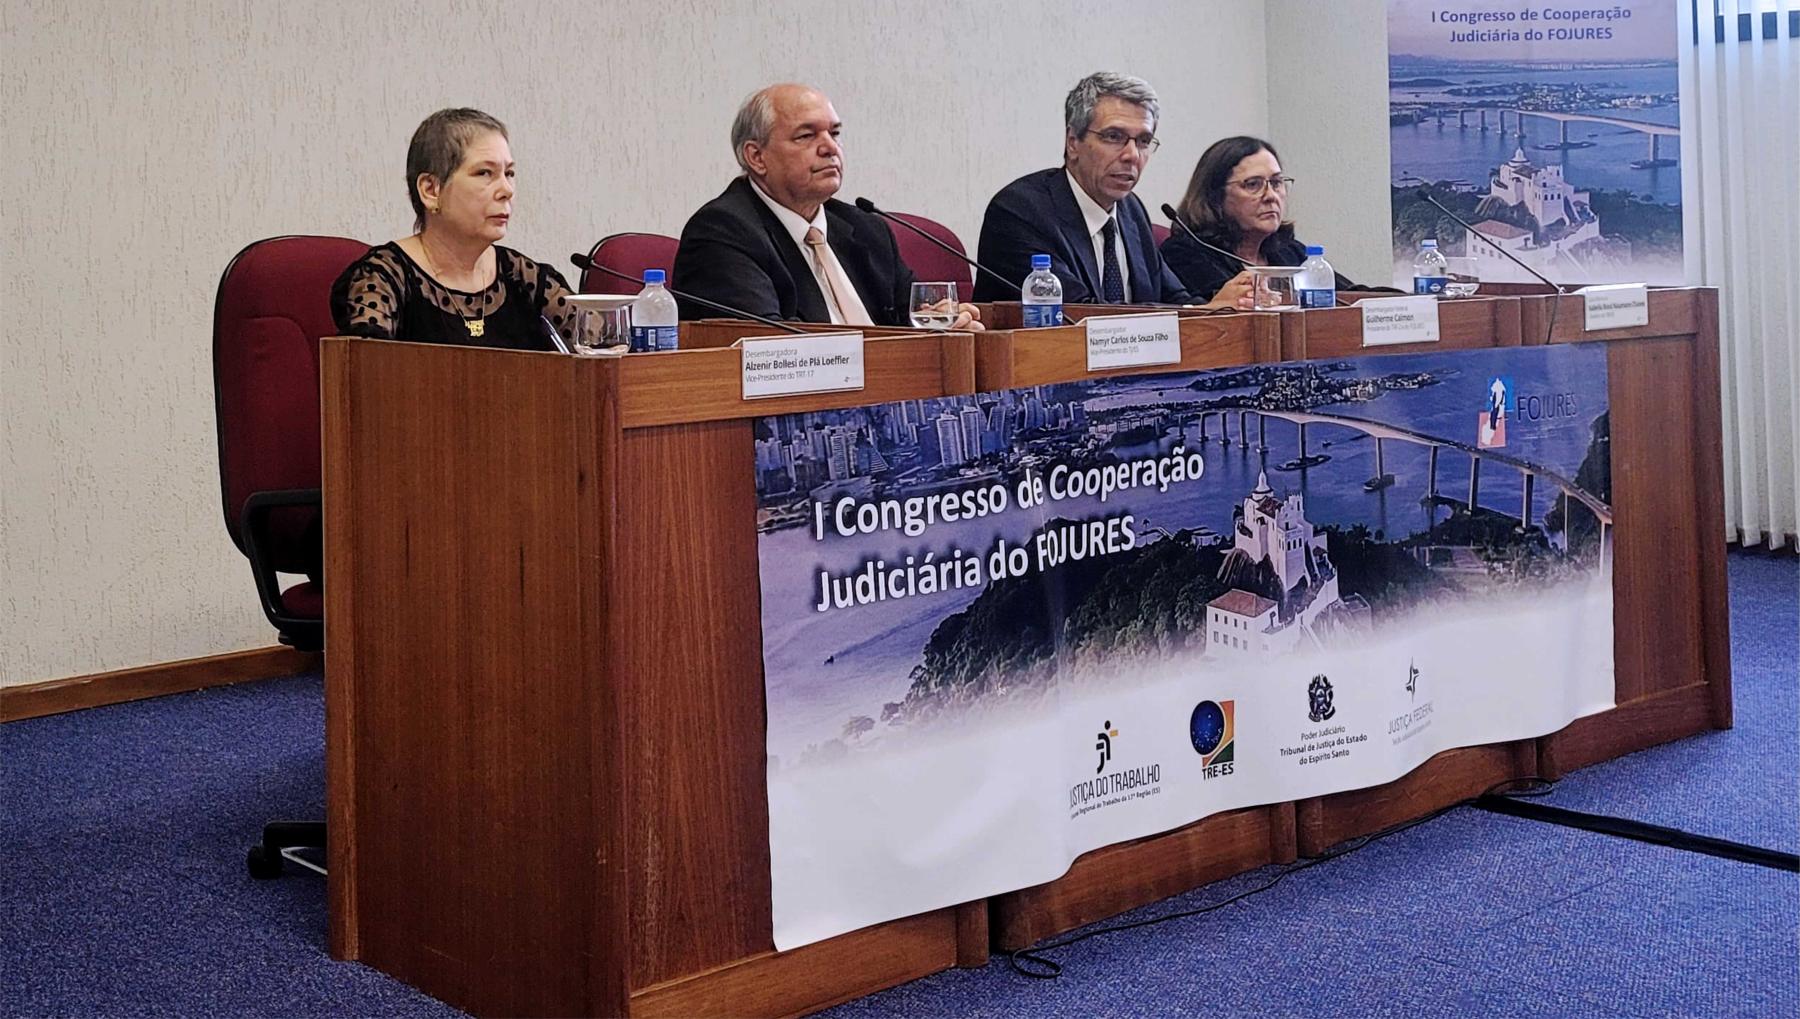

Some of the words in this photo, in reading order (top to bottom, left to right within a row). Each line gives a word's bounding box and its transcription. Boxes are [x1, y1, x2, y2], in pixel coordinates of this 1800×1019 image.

[1432, 11, 1436, 22] I
[1440, 9, 1516, 26] Congresso
[1520, 8, 1538, 21] de
[1543, 7, 1631, 25] Cooperação
[1450, 28, 1519, 43] Judiciária
[1524, 28, 1543, 41] do
[1548, 27, 1613, 41] FOJURES
[1090, 338, 1110, 347] Namyr
[1110, 336, 1129, 344] Carlos
[1129, 335, 1137, 343] de
[1137, 334, 1154, 342] Souza
[1154, 332, 1169, 341] Filho
[745, 348, 798, 359] Desembargadora
[745, 359, 772, 371] Alzenir
[773, 358, 798, 370] Bollesi
[798, 358, 808, 368] de
[821, 355, 850, 366] Loeffler
[745, 373, 787, 383] Vice-Presidente
[1517, 392, 1577, 421] FOJURES
[815, 501, 824, 540] I
[835, 484, 1007, 538] Congresso
[1017, 468, 1044, 510] de
[1049, 447, 1204, 502] Cooperação
[816, 549, 982, 612] Judiciária
[989, 540, 1029, 580] do
[1037, 515, 1136, 572] FOJURES
[1301, 731, 1318, 741] Poder
[1319, 726, 1346, 737] Judiciário
[1280, 745, 1307, 757] Tribunal
[1307, 743, 1315, 752] de
[1316, 738, 1336, 749] Justiça
[1336, 737, 1345, 746] do
[1346, 733, 1368, 744] Estado
[1299, 757, 1308, 766] do
[1331, 749, 1350, 759] Santo
[1202, 763, 1234, 780] TRE-ES
[1096, 776, 1108, 797] DO
[1109, 764, 1160, 793] TRABALHO
[1102, 797, 1121, 808] Trabalho
